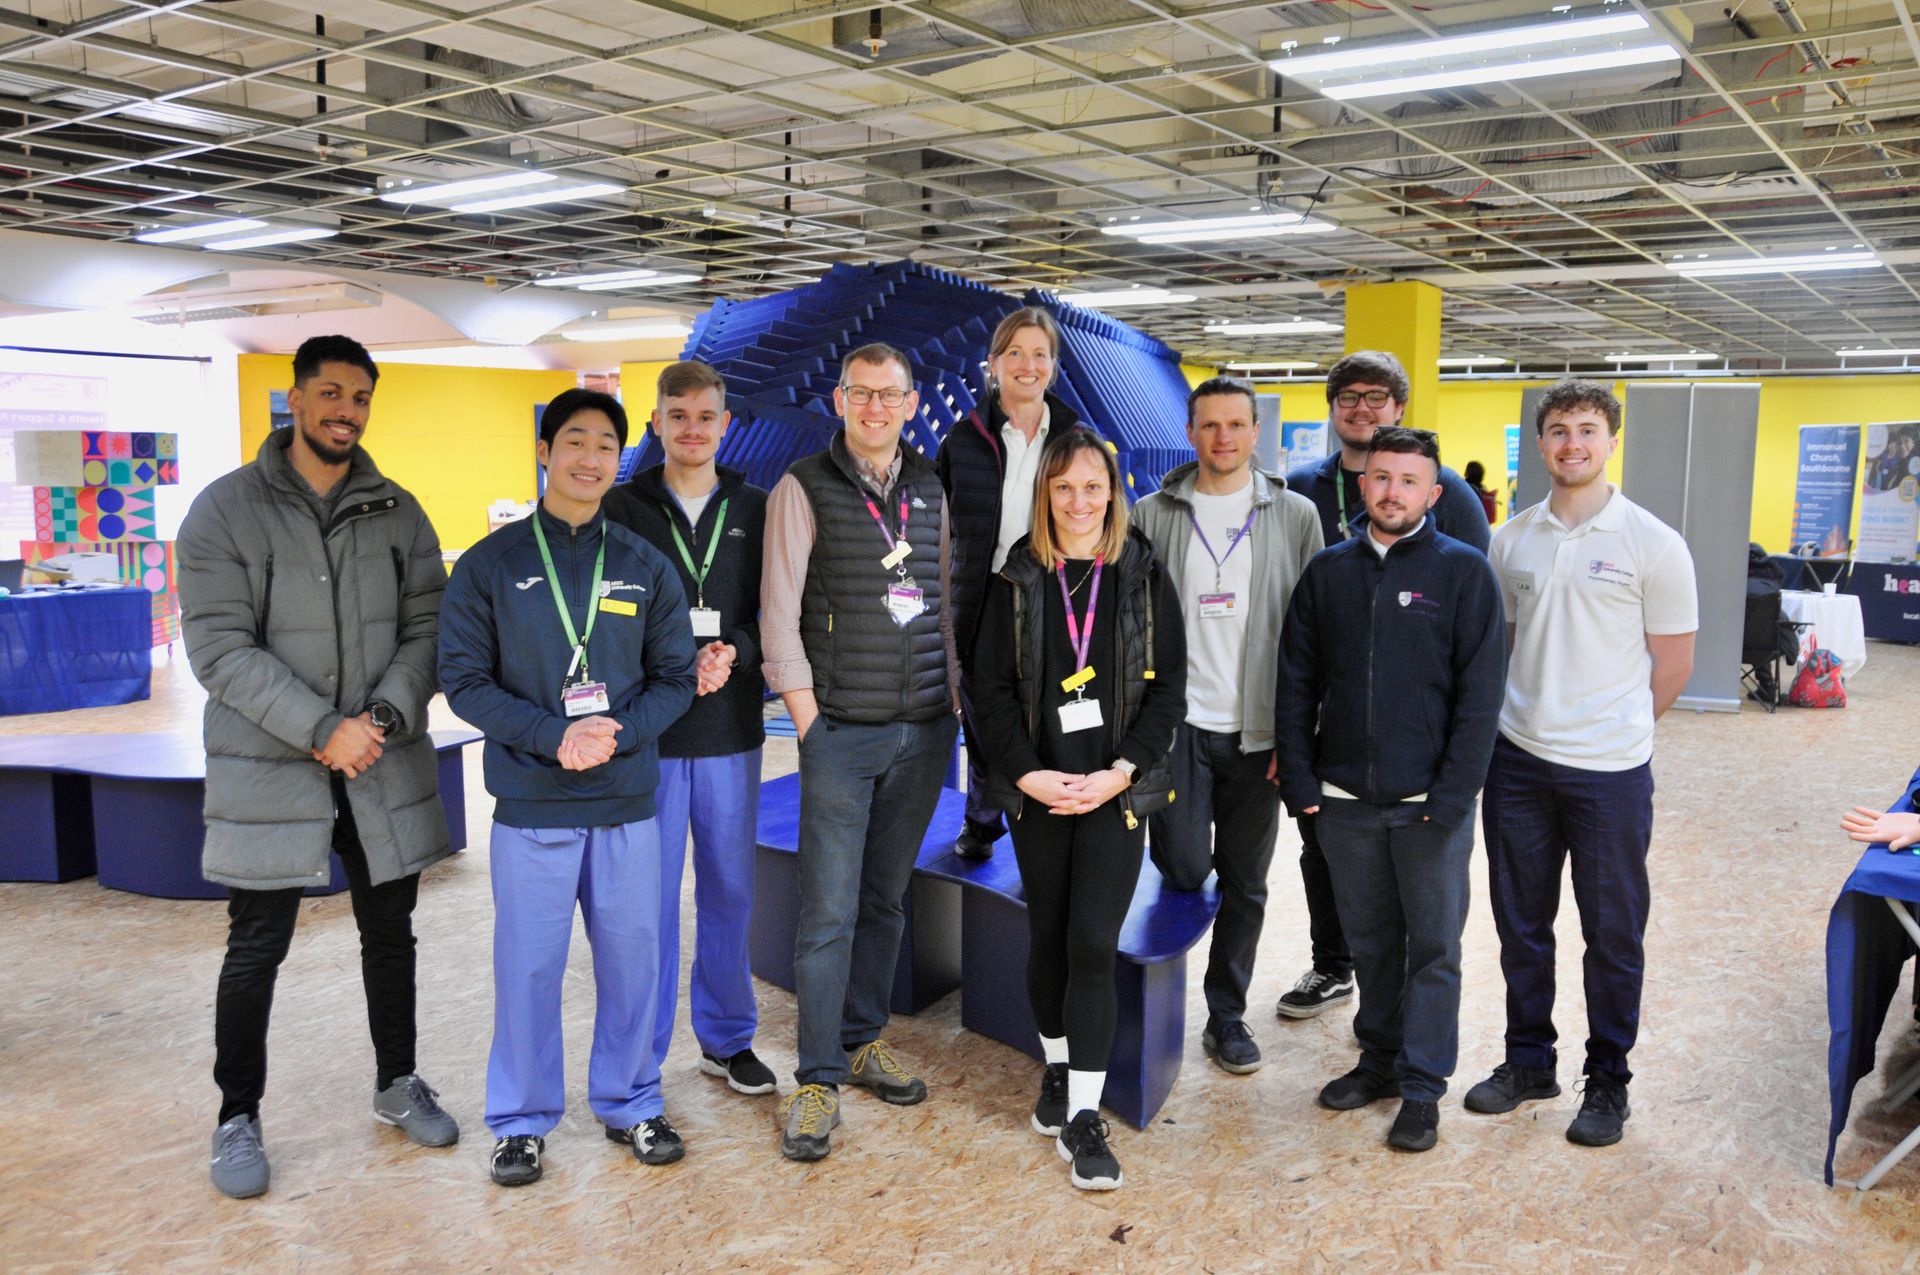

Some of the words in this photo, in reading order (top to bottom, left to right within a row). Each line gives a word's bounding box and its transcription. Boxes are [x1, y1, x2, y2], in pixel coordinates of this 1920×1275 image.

[1806, 442, 1847, 451] Immanuel
[1810, 454, 1840, 462] Church,
[1800, 464, 1851, 473] Southbourne
[1883, 573, 1920, 594] hea
[1903, 612, 1919, 620] local
